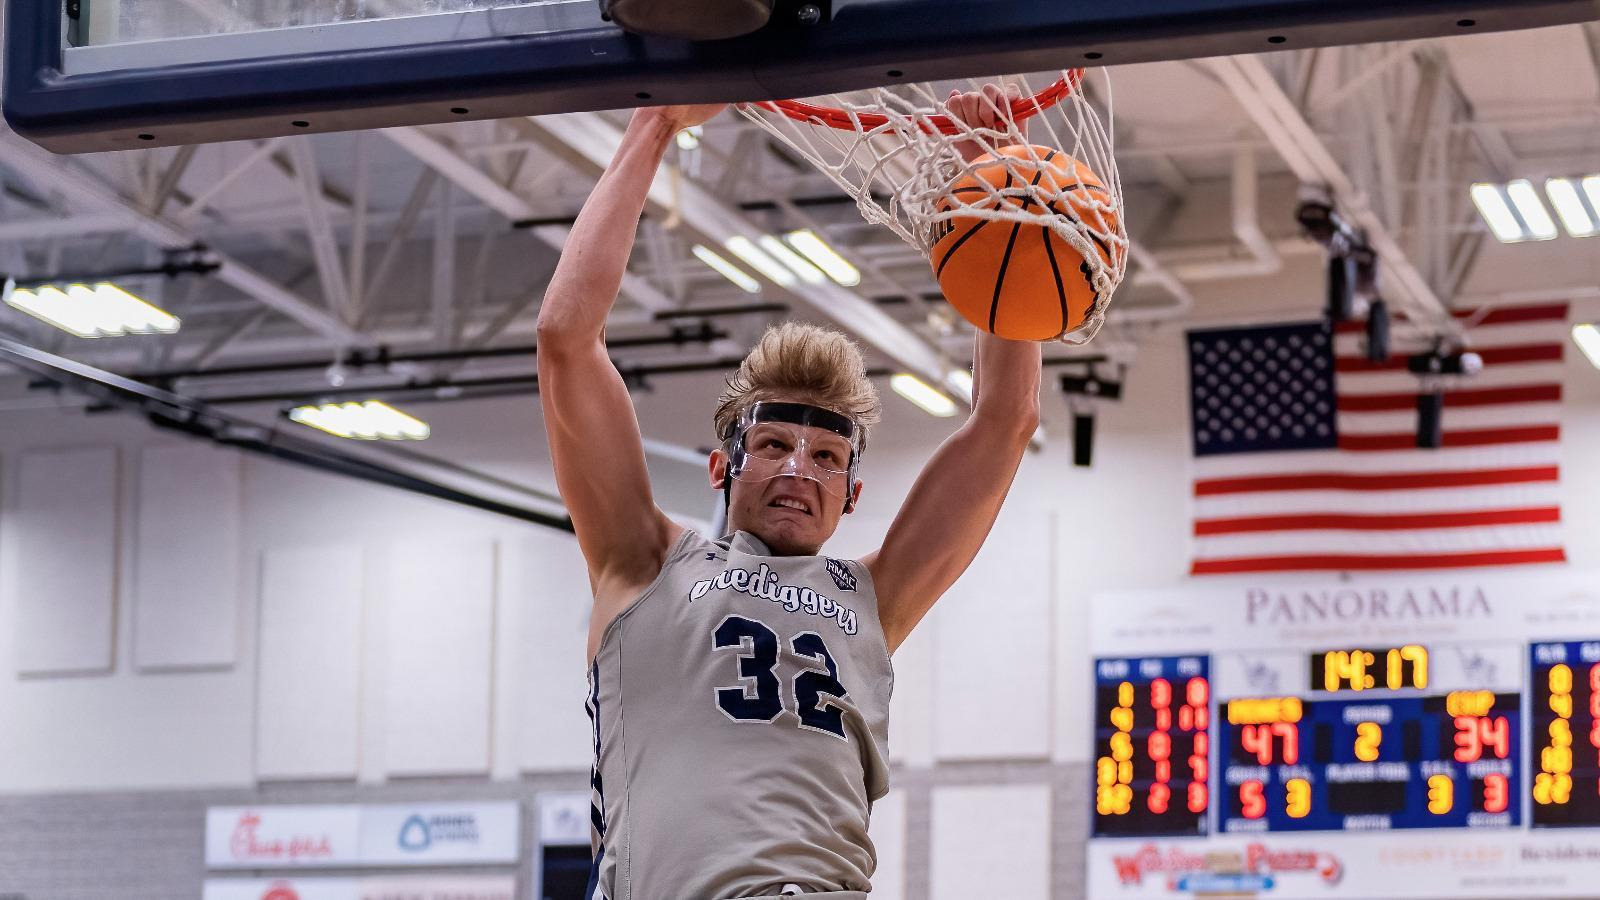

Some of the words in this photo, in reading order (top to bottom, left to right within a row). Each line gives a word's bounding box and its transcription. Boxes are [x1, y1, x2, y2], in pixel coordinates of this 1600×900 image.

[826, 559, 857, 590] RMAC
[1245, 585, 1494, 626] PANORAMA
[711, 613, 849, 743] 32
[1325, 645, 1428, 692] 14:17
[1242, 722, 1299, 766] 47
[1354, 722, 1382, 762] 2
[1454, 716, 1510, 763] 34
[1240, 778, 1266, 820] 5
[1286, 778, 1311, 818] 3
[1428, 774, 1453, 815] 3
[1484, 772, 1508, 813] 3
